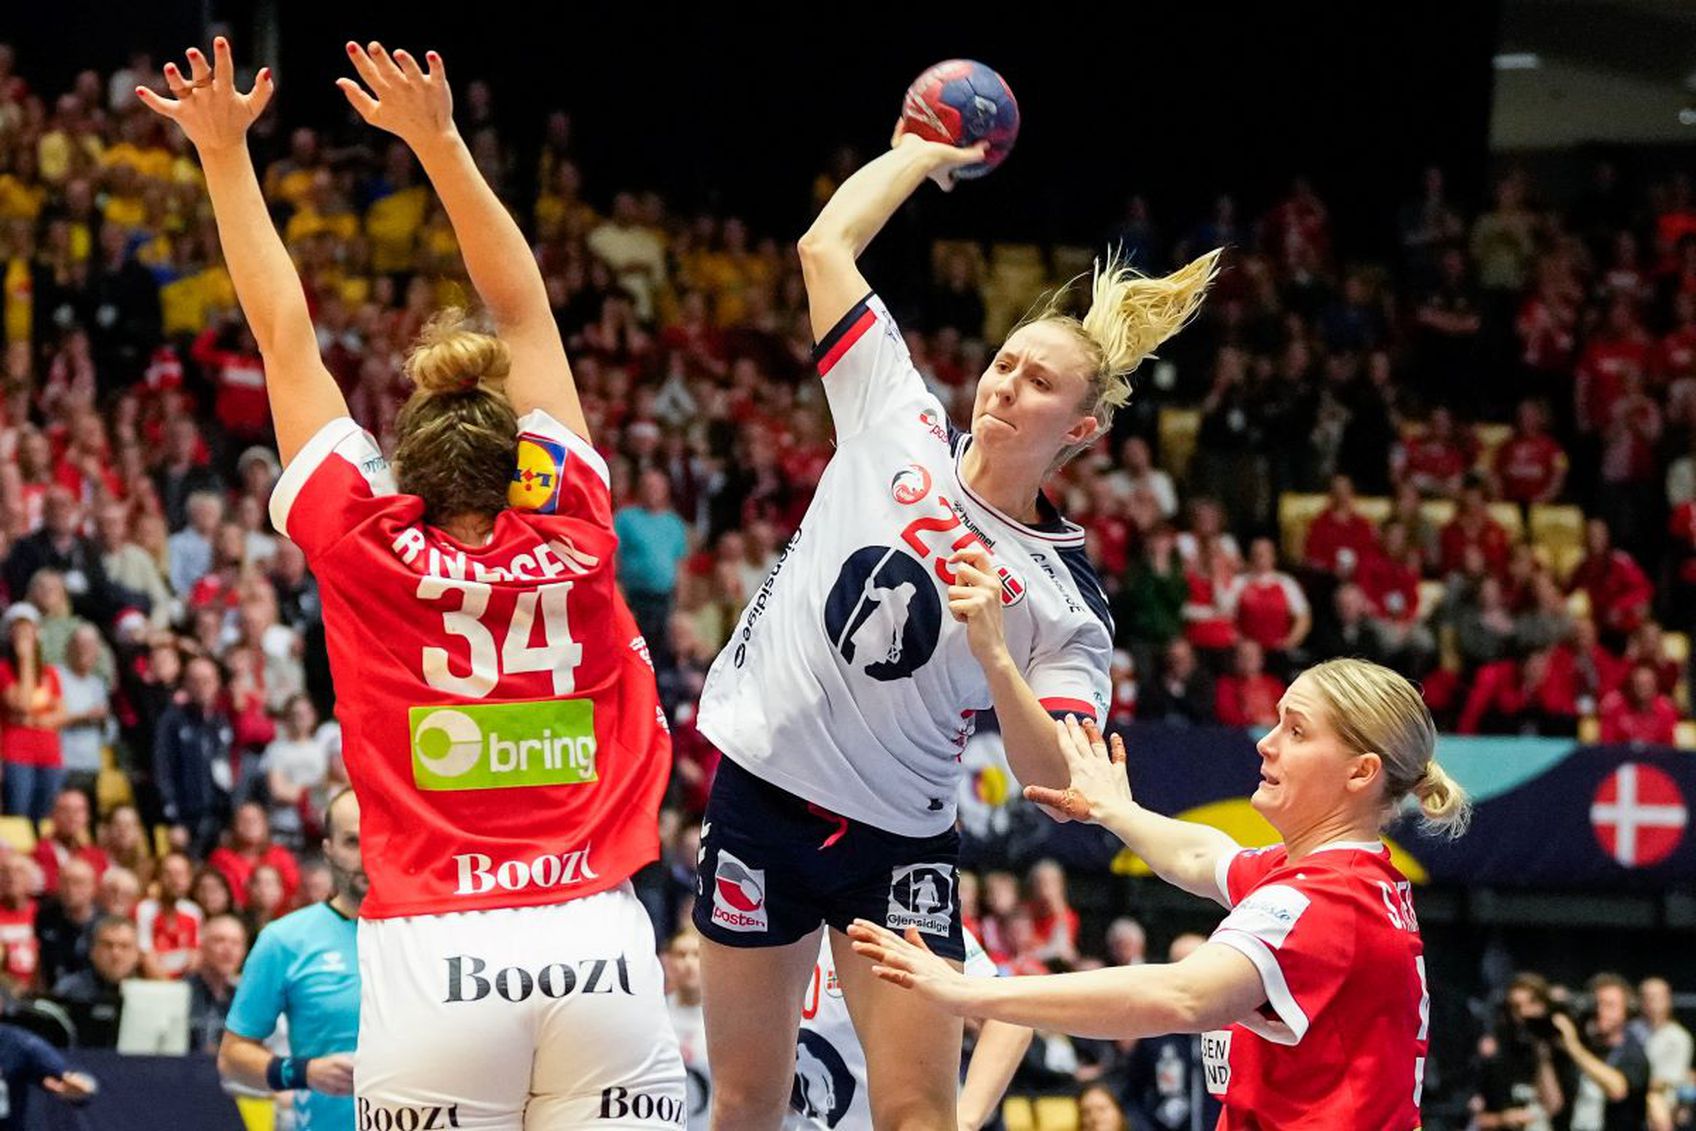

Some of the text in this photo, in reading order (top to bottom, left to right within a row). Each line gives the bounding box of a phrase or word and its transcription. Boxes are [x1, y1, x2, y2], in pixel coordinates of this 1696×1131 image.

[960, 512, 996, 549] hummel
[415, 576, 583, 699] 34
[489, 730, 596, 778] bring
[714, 906, 765, 928] posten
[887, 914, 948, 932] Gjensidige
[442, 952, 636, 1003] Boozt
[597, 1086, 686, 1125] Booz
